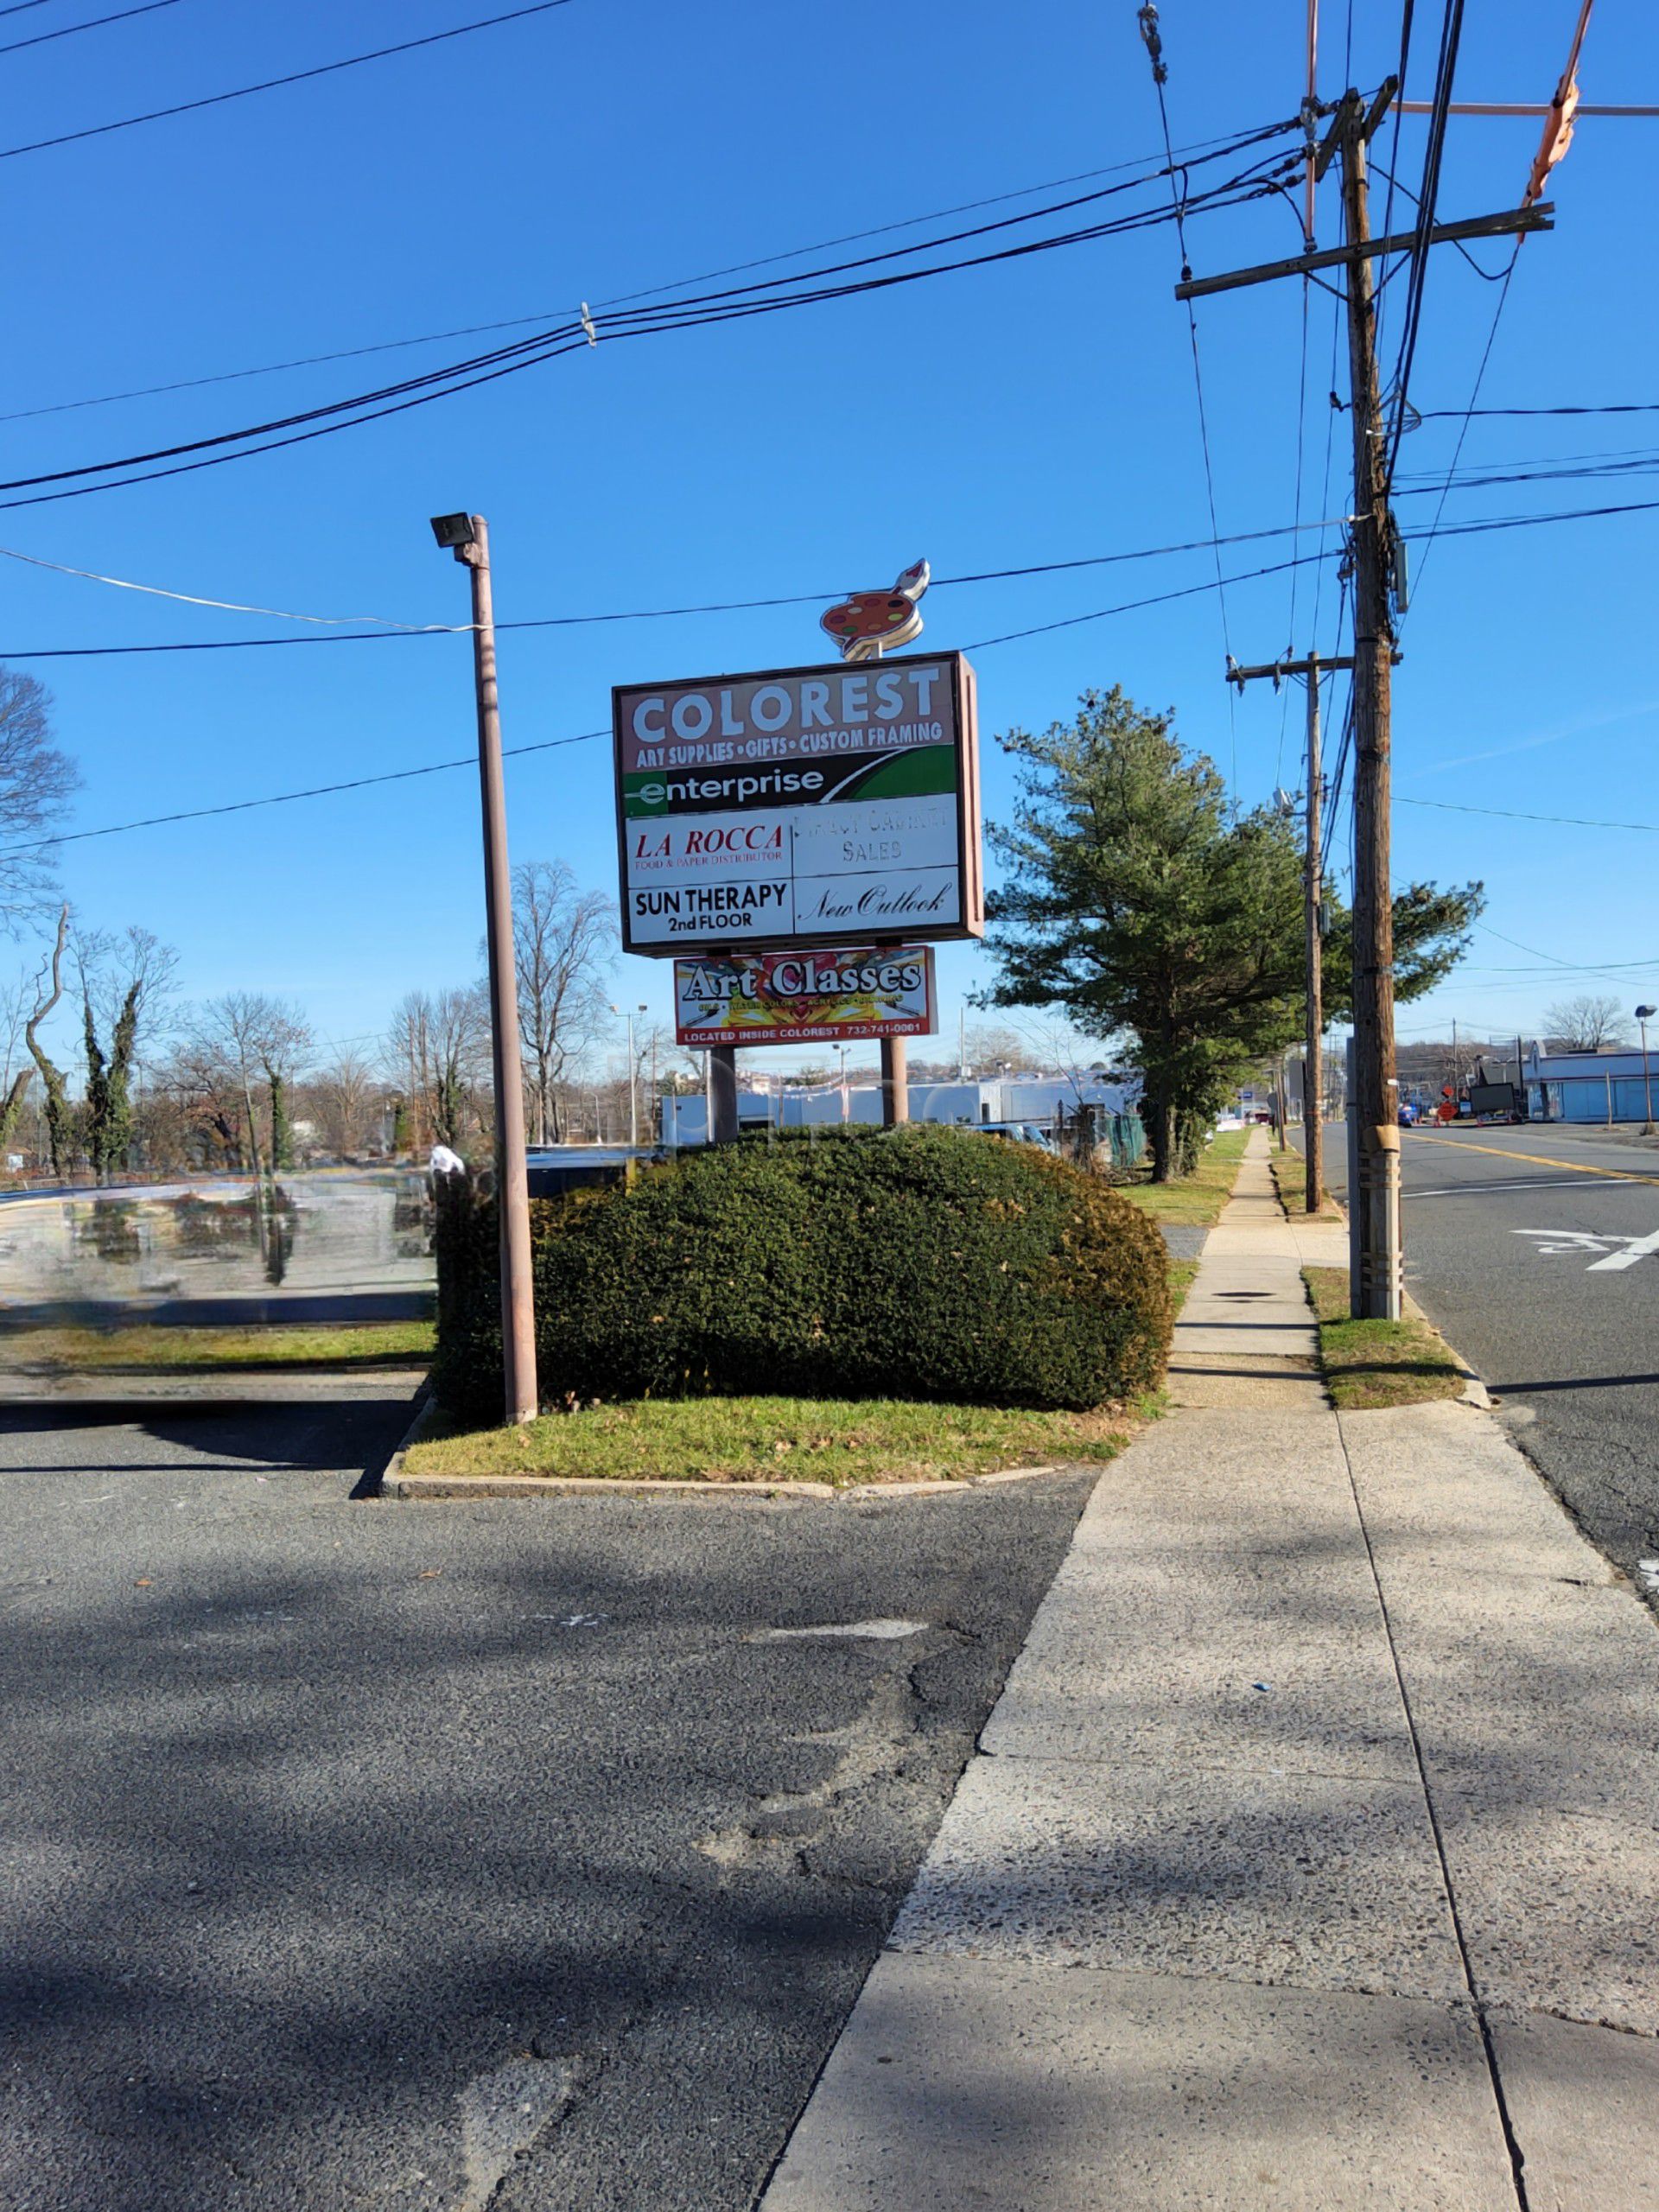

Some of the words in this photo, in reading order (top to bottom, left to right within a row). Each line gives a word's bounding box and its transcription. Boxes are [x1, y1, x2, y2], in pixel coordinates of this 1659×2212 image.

[633, 668, 939, 742] COLOREST
[637, 747, 664, 767] ART
[669, 742, 734, 765] SUPPLIES
[746, 737, 787, 760] GIFTS
[800, 729, 863, 753] CUSTOM
[868, 721, 943, 746] FRAMING
[638, 768, 824, 804] enterprise
[635, 833, 671, 859] LA
[685, 825, 783, 855] ROCCA
[843, 841, 901, 861] SALES
[635, 861, 663, 870] FOOD
[677, 856, 708, 868] PAPER
[711, 851, 782, 864] DISTRIBUTOR
[636, 891, 680, 916] SUN
[685, 883, 787, 912] THERAPY
[798, 888, 853, 920] New
[857, 881, 952, 916] Outlook
[668, 916, 696, 931] 2nd
[700, 912, 752, 929] FLOOR
[682, 963, 757, 1001] Art
[772, 957, 921, 996] Classes
[684, 1032, 735, 1042] LOCATED
[739, 1029, 776, 1039] INSIDE
[779, 1027, 840, 1037] COLOREST
